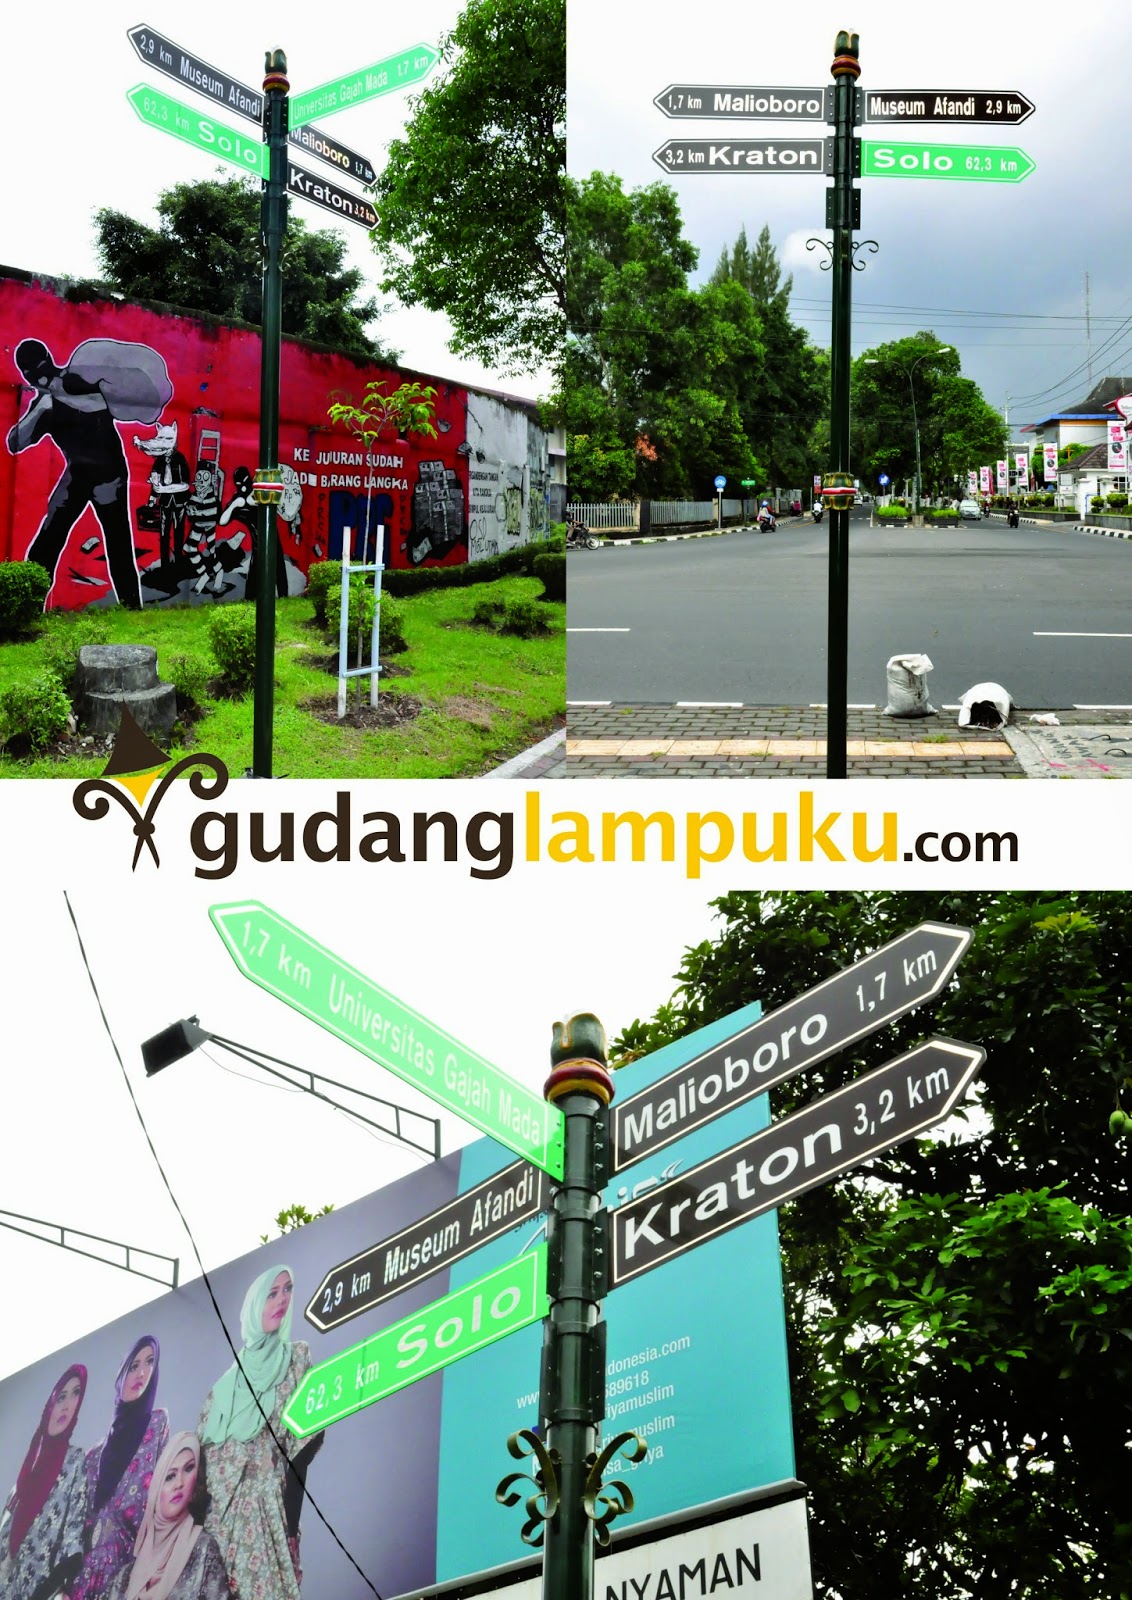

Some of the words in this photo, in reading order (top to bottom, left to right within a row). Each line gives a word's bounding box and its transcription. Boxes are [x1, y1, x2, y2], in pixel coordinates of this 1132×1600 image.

[140, 34, 155, 54] 2,9
[160, 45, 172, 66] km
[180, 56, 224, 97] Museum
[228, 85, 260, 117] Afandi
[294, 90, 337, 120] Universitas
[340, 80, 363, 103] Gajah
[365, 70, 388, 92] Mada
[414, 55, 429, 70] km
[143, 97, 168, 120] 62,3
[175, 112, 190, 131] km
[197, 120, 257, 164] Solo
[668, 95, 685, 110] 1,7
[688, 95, 702, 110] km
[713, 93, 820, 114] Malioboro
[870, 97, 925, 115] Museum
[933, 97, 975, 115] Afandi
[986, 100, 1003, 115] 2,9
[1007, 101, 1022, 115] km
[291, 127, 350, 169] Malioboro
[365, 167, 374, 180] km
[665, 150, 685, 165] 3,2
[688, 149, 705, 164] km
[709, 146, 818, 166] Kraton
[874, 149, 953, 171] Solo
[965, 157, 992, 173] 62,3
[1000, 158, 1018, 173] km
[290, 168, 353, 214] Kraton
[354, 203, 365, 218] 3,2
[366, 208, 376, 223] km
[284, 470, 317, 487] JAD
[320, 474, 361, 489] BRANG
[364, 476, 408, 490] LANGKA
[294, 448, 310, 462] KE
[366, 454, 404, 469] SUDAH
[241, 920, 271, 958] 1,7
[278, 944, 311, 990] km
[328, 973, 436, 1077] Universitas
[444, 1054, 491, 1115] Gajah
[499, 1088, 540, 1146] Mada
[623, 1013, 828, 1151] Malioboro
[857, 972, 887, 1012] 1,7
[903, 949, 937, 986] km
[624, 1123, 843, 1260] Kraton
[853, 1089, 895, 1135] 3,2
[907, 1067, 950, 1109] km
[321, 1281, 344, 1314] 2,9
[350, 1271, 370, 1298] km
[383, 1218, 460, 1285] Museum
[470, 1166, 533, 1237] Afandi
[305, 1374, 343, 1415] 62,3
[355, 1356, 380, 1391] km
[396, 1286, 521, 1369] Solo
[605, 1336, 690, 1376] donesia.com
